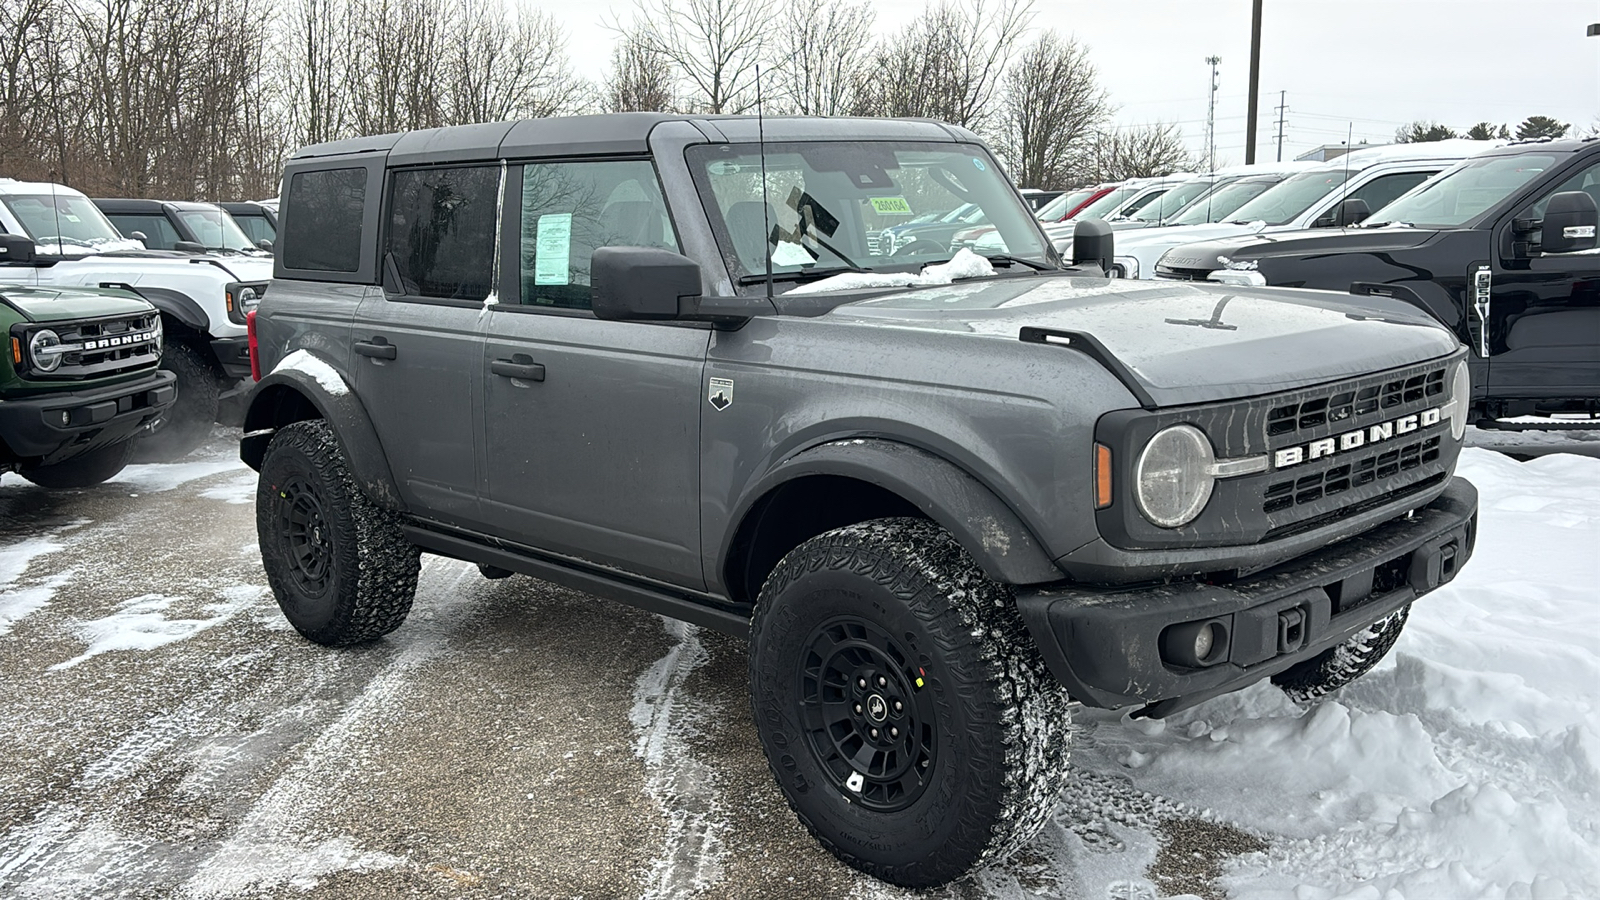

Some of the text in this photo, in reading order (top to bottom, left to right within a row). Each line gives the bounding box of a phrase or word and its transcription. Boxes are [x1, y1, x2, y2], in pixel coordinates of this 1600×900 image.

[875, 200, 906, 211] 260164
[84, 332, 152, 350] BRONCO
[1275, 407, 1440, 468] BRONCO
